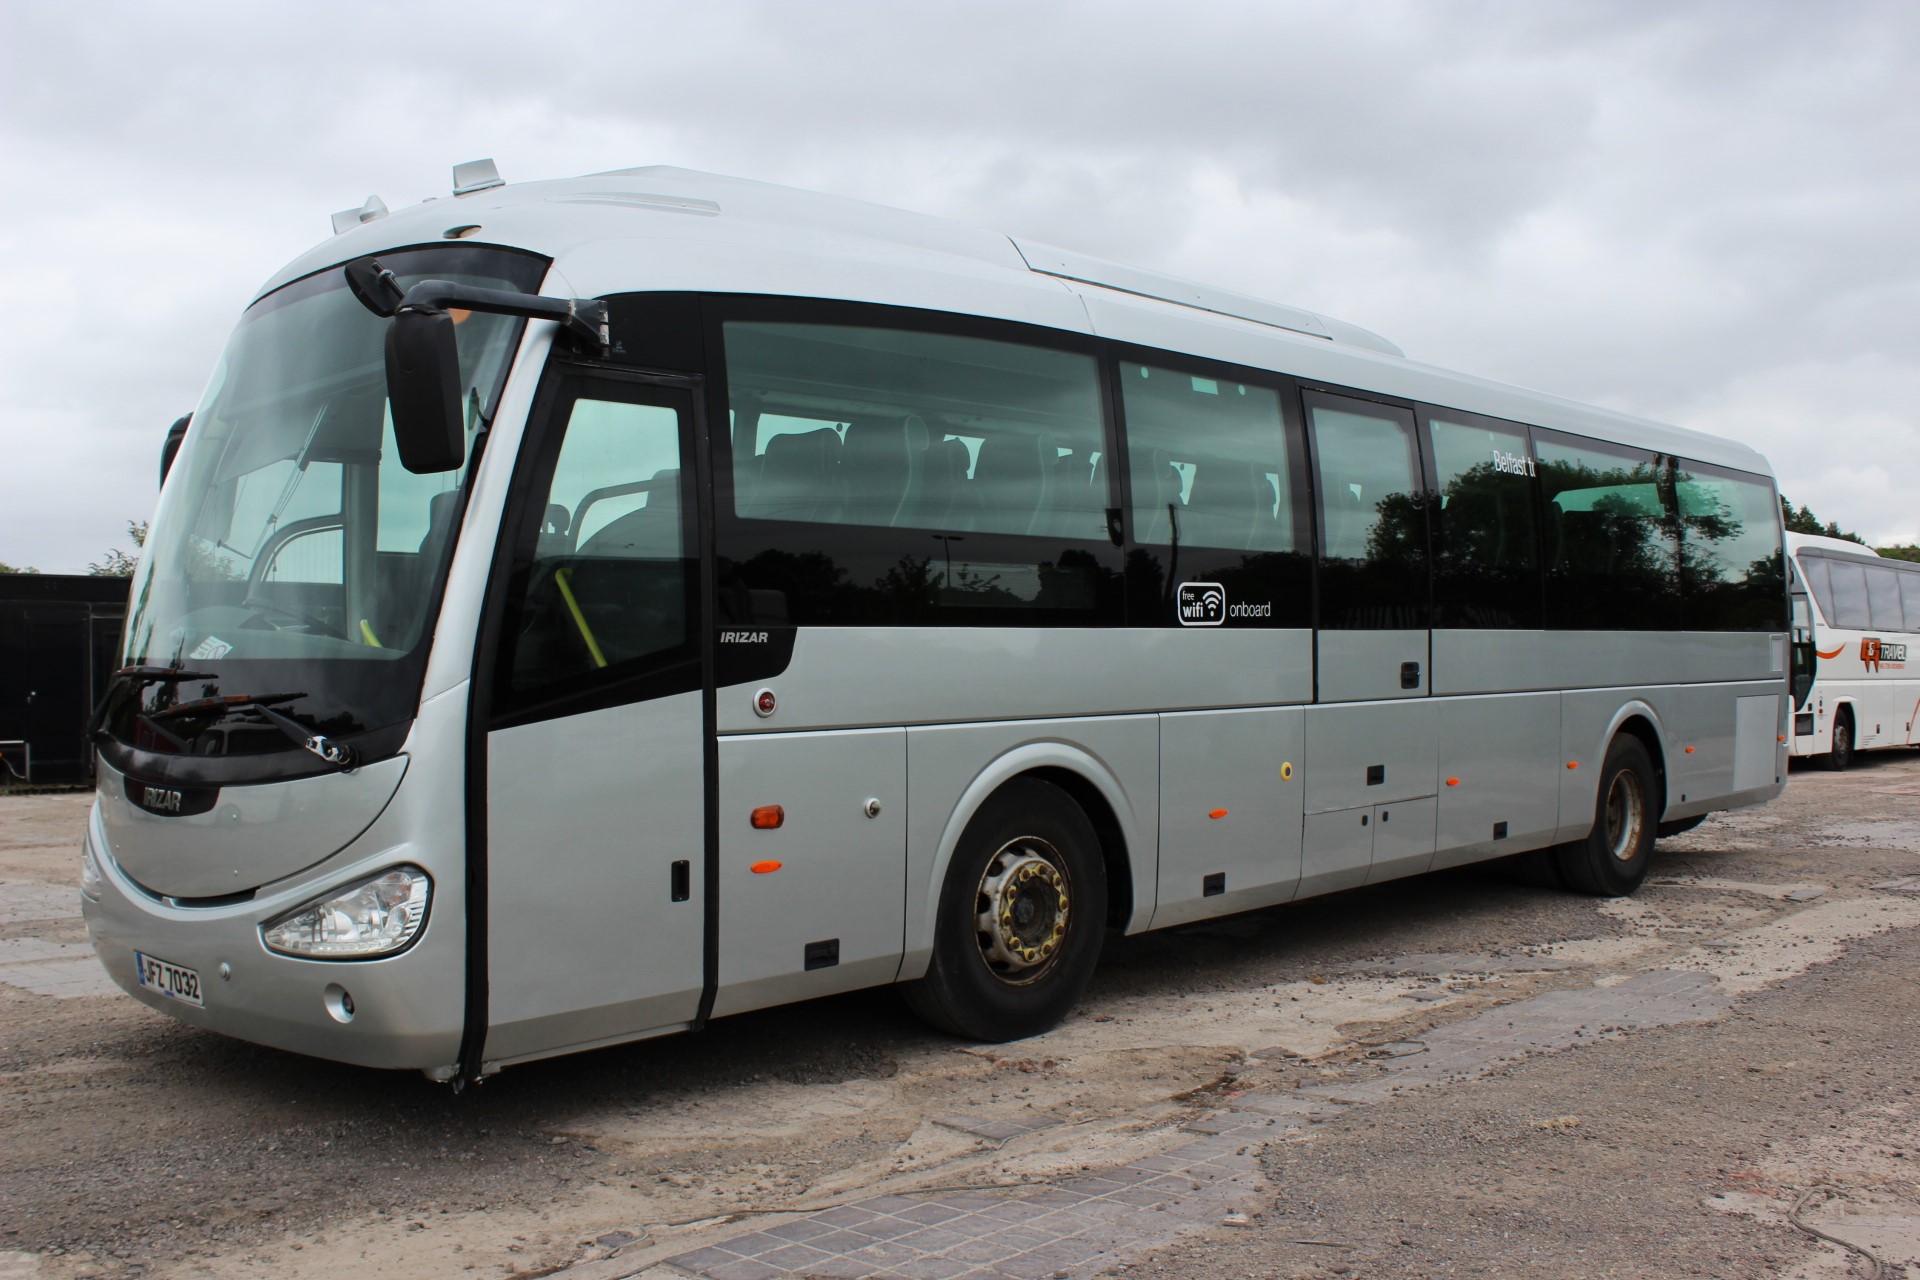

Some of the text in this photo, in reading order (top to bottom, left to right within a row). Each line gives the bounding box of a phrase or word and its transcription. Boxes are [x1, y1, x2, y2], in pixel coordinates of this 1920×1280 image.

[1493, 450, 1528, 476] Belfast
[1182, 590, 1195, 601] free
[1182, 601, 1204, 618] wifi
[1229, 600, 1271, 617] onboard
[720, 631, 769, 643] IRIZAR
[1880, 644, 1906, 660] TRAVEL
[143, 786, 182, 812] IRIZAR
[165, 966, 200, 1000] 7032
